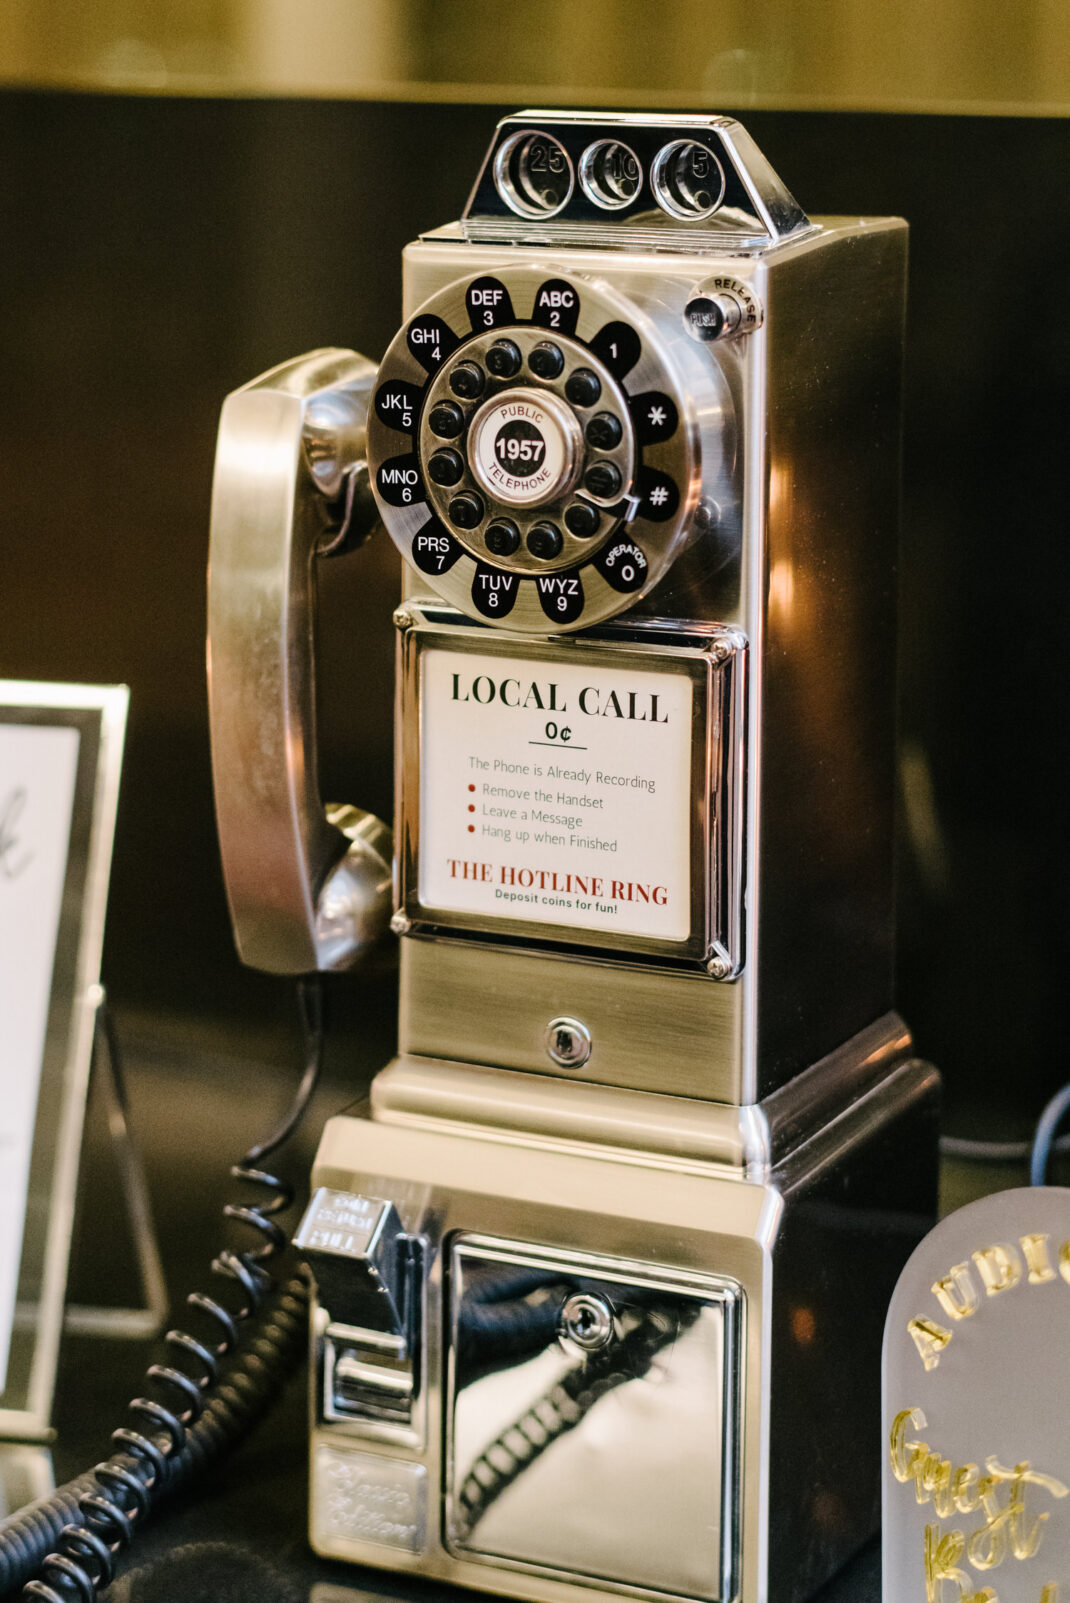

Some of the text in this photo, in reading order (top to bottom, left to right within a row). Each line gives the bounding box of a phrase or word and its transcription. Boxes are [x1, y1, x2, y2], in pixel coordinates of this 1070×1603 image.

[530, 145, 566, 173] 25
[611, 153, 638, 180] 10
[692, 151, 709, 178] 5
[471, 290, 503, 305] DEF
[539, 291, 574, 308] ABC
[714, 279, 756, 323] RELEASE
[483, 311, 494, 326] 3
[549, 311, 560, 327] 2
[690, 312, 716, 327] PUSH
[411, 328, 440, 344] GHI
[431, 347, 441, 360] 4
[609, 343, 617, 359] 1
[381, 394, 413, 410] JKL
[402, 412, 412, 427] 5
[501, 406, 543, 423] PUBLIC
[496, 438, 544, 461] 1957
[381, 469, 418, 485] MNO
[489, 462, 551, 491] TELEPHONE
[402, 488, 412, 502] 6
[418, 537, 450, 552] PRS
[436, 555, 445, 570] 7
[605, 544, 647, 568] OPERATOR
[479, 574, 513, 591] TUV
[539, 578, 578, 595] WYZ
[488, 592, 499, 607] 8
[557, 596, 567, 611] 9
[452, 673, 668, 723] LOCAL CALL
[545, 721, 572, 743] 0¢
[469, 756, 656, 794] The Phone is Already Recording
[482, 783, 603, 809] Remove the Handset
[482, 803, 583, 830] Leave a Message
[482, 824, 618, 852] Hang up when Finished
[447, 859, 668, 906] THE HOTLINE RING
[495, 888, 618, 914] Deposit coins for fun!
[907, 1233, 1070, 1372] AUDI
